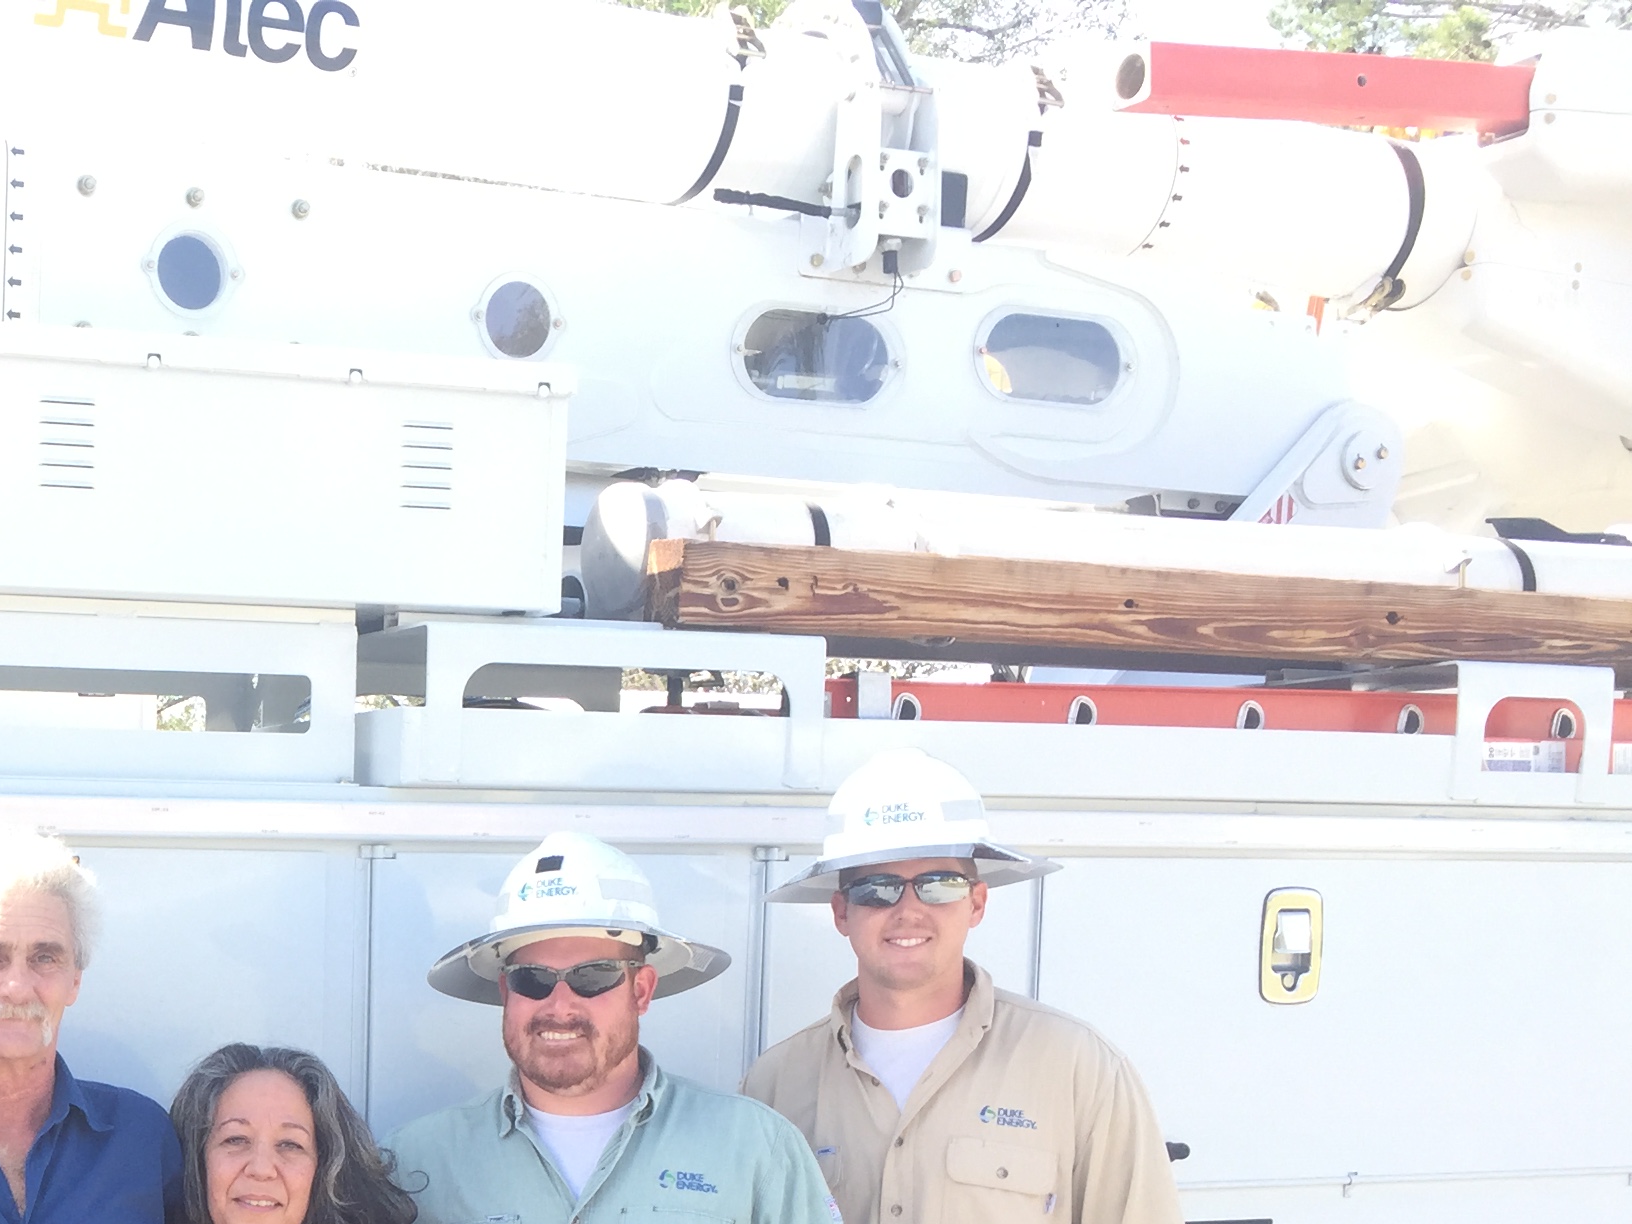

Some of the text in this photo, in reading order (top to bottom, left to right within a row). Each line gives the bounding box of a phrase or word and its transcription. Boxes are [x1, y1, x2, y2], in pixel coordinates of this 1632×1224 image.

[881, 802, 909, 814] DUKE
[882, 811, 925, 825] ENERGY
[536, 877, 563, 888] DUKE
[536, 885, 577, 899] ENERGY
[997, 1107, 1025, 1119] DUKE
[996, 1116, 1037, 1130] ENERGY
[676, 1171, 705, 1183] DUKE
[675, 1180, 717, 1194] ENERGY
